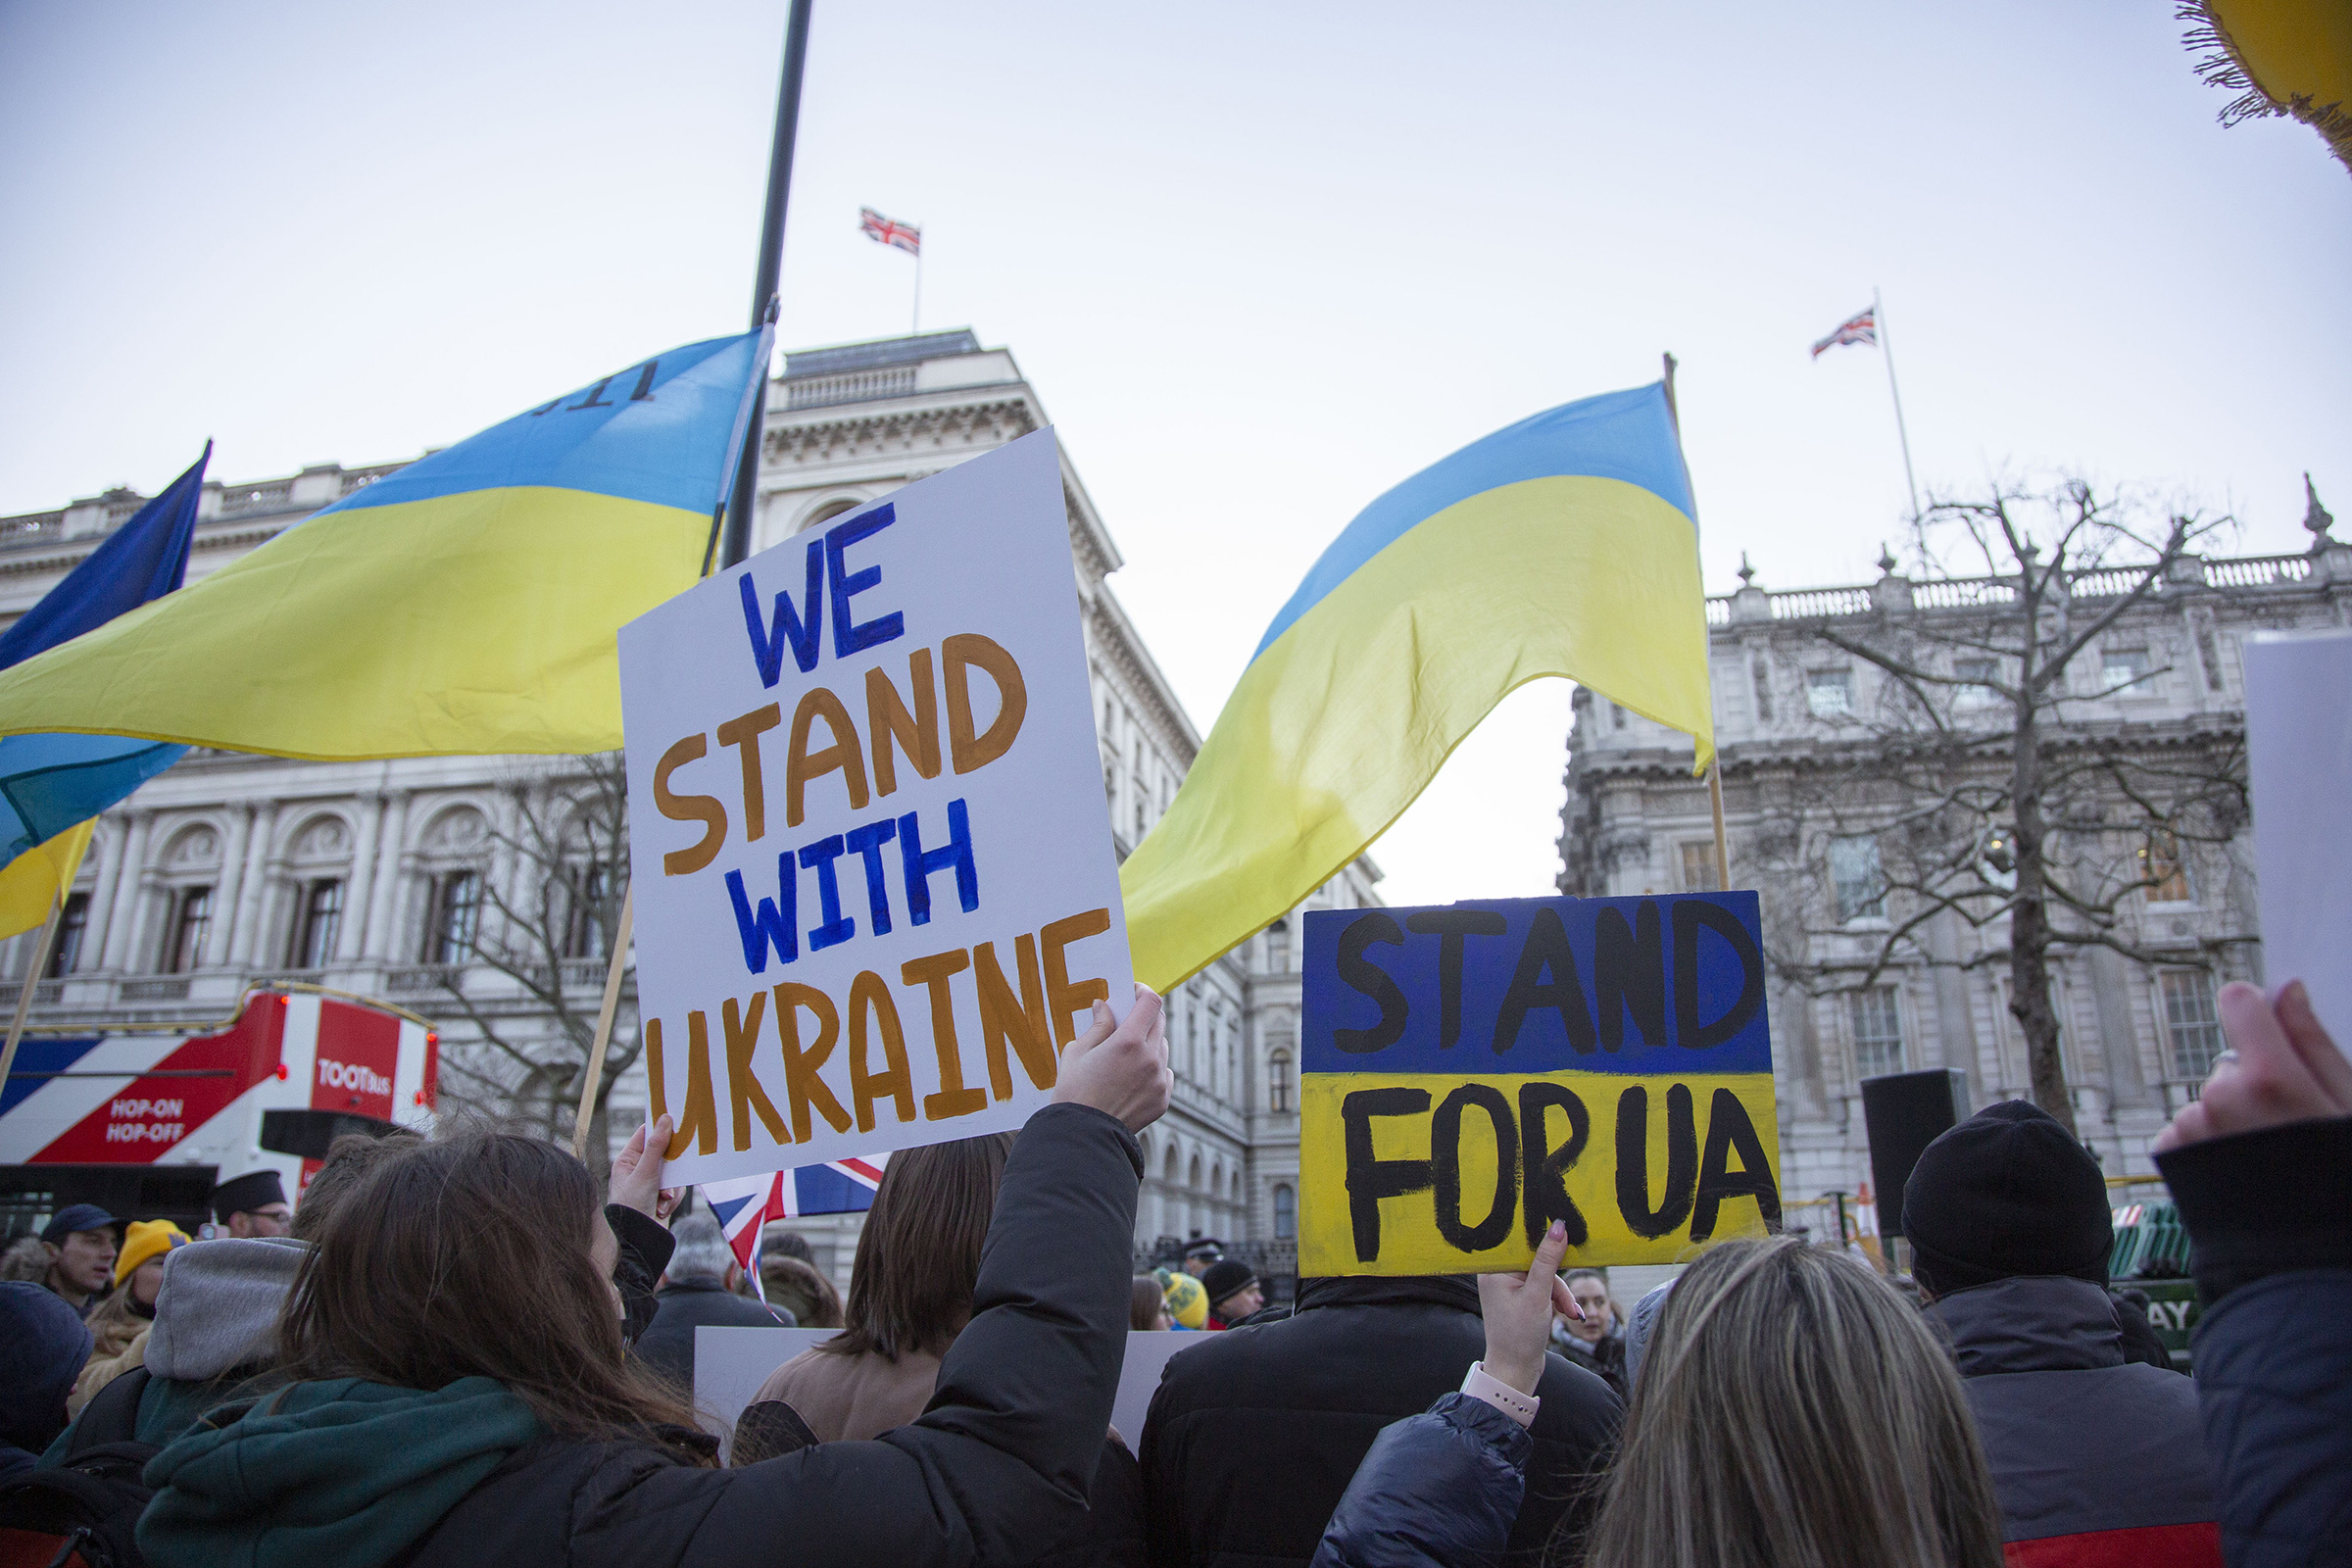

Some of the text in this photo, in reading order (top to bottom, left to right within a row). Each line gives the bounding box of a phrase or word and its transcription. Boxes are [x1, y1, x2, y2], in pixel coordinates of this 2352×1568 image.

[739, 503, 904, 689] WE
[653, 633, 1027, 875] STAND
[724, 798, 979, 974] WITH
[647, 907, 1110, 1161] UKRAINE
[1333, 900, 1764, 1055] STAND
[106, 1123, 185, 1144] HOP-OFF
[111, 1099, 184, 1118] HOP-ON
[1342, 1082, 1783, 1262] FOR UA
